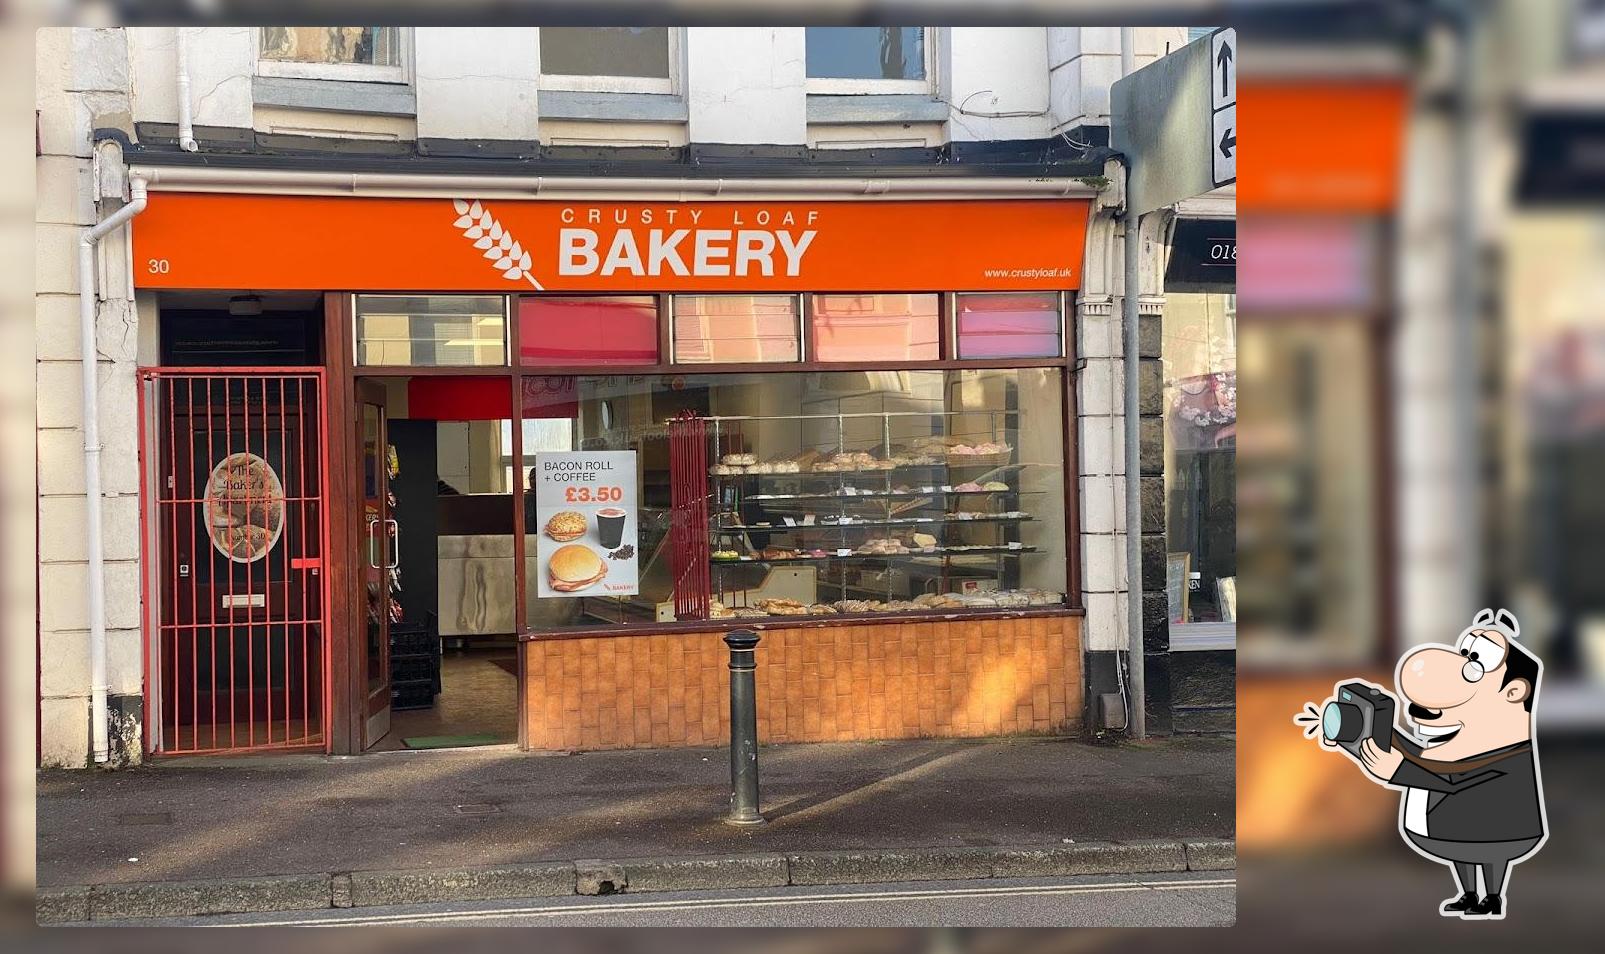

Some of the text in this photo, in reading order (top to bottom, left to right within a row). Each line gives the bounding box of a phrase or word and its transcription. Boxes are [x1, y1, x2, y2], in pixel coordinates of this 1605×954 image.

[561, 208, 819, 226] CRUSTY LOAF
[558, 228, 819, 277] BAKERY
[148, 259, 170, 274] 30
[984, 268, 1072, 280] www.crustyloaf.uk
[544, 460, 614, 471] BACON ROLL
[553, 472, 596, 482] COFFEE
[565, 486, 623, 502] £3.50
